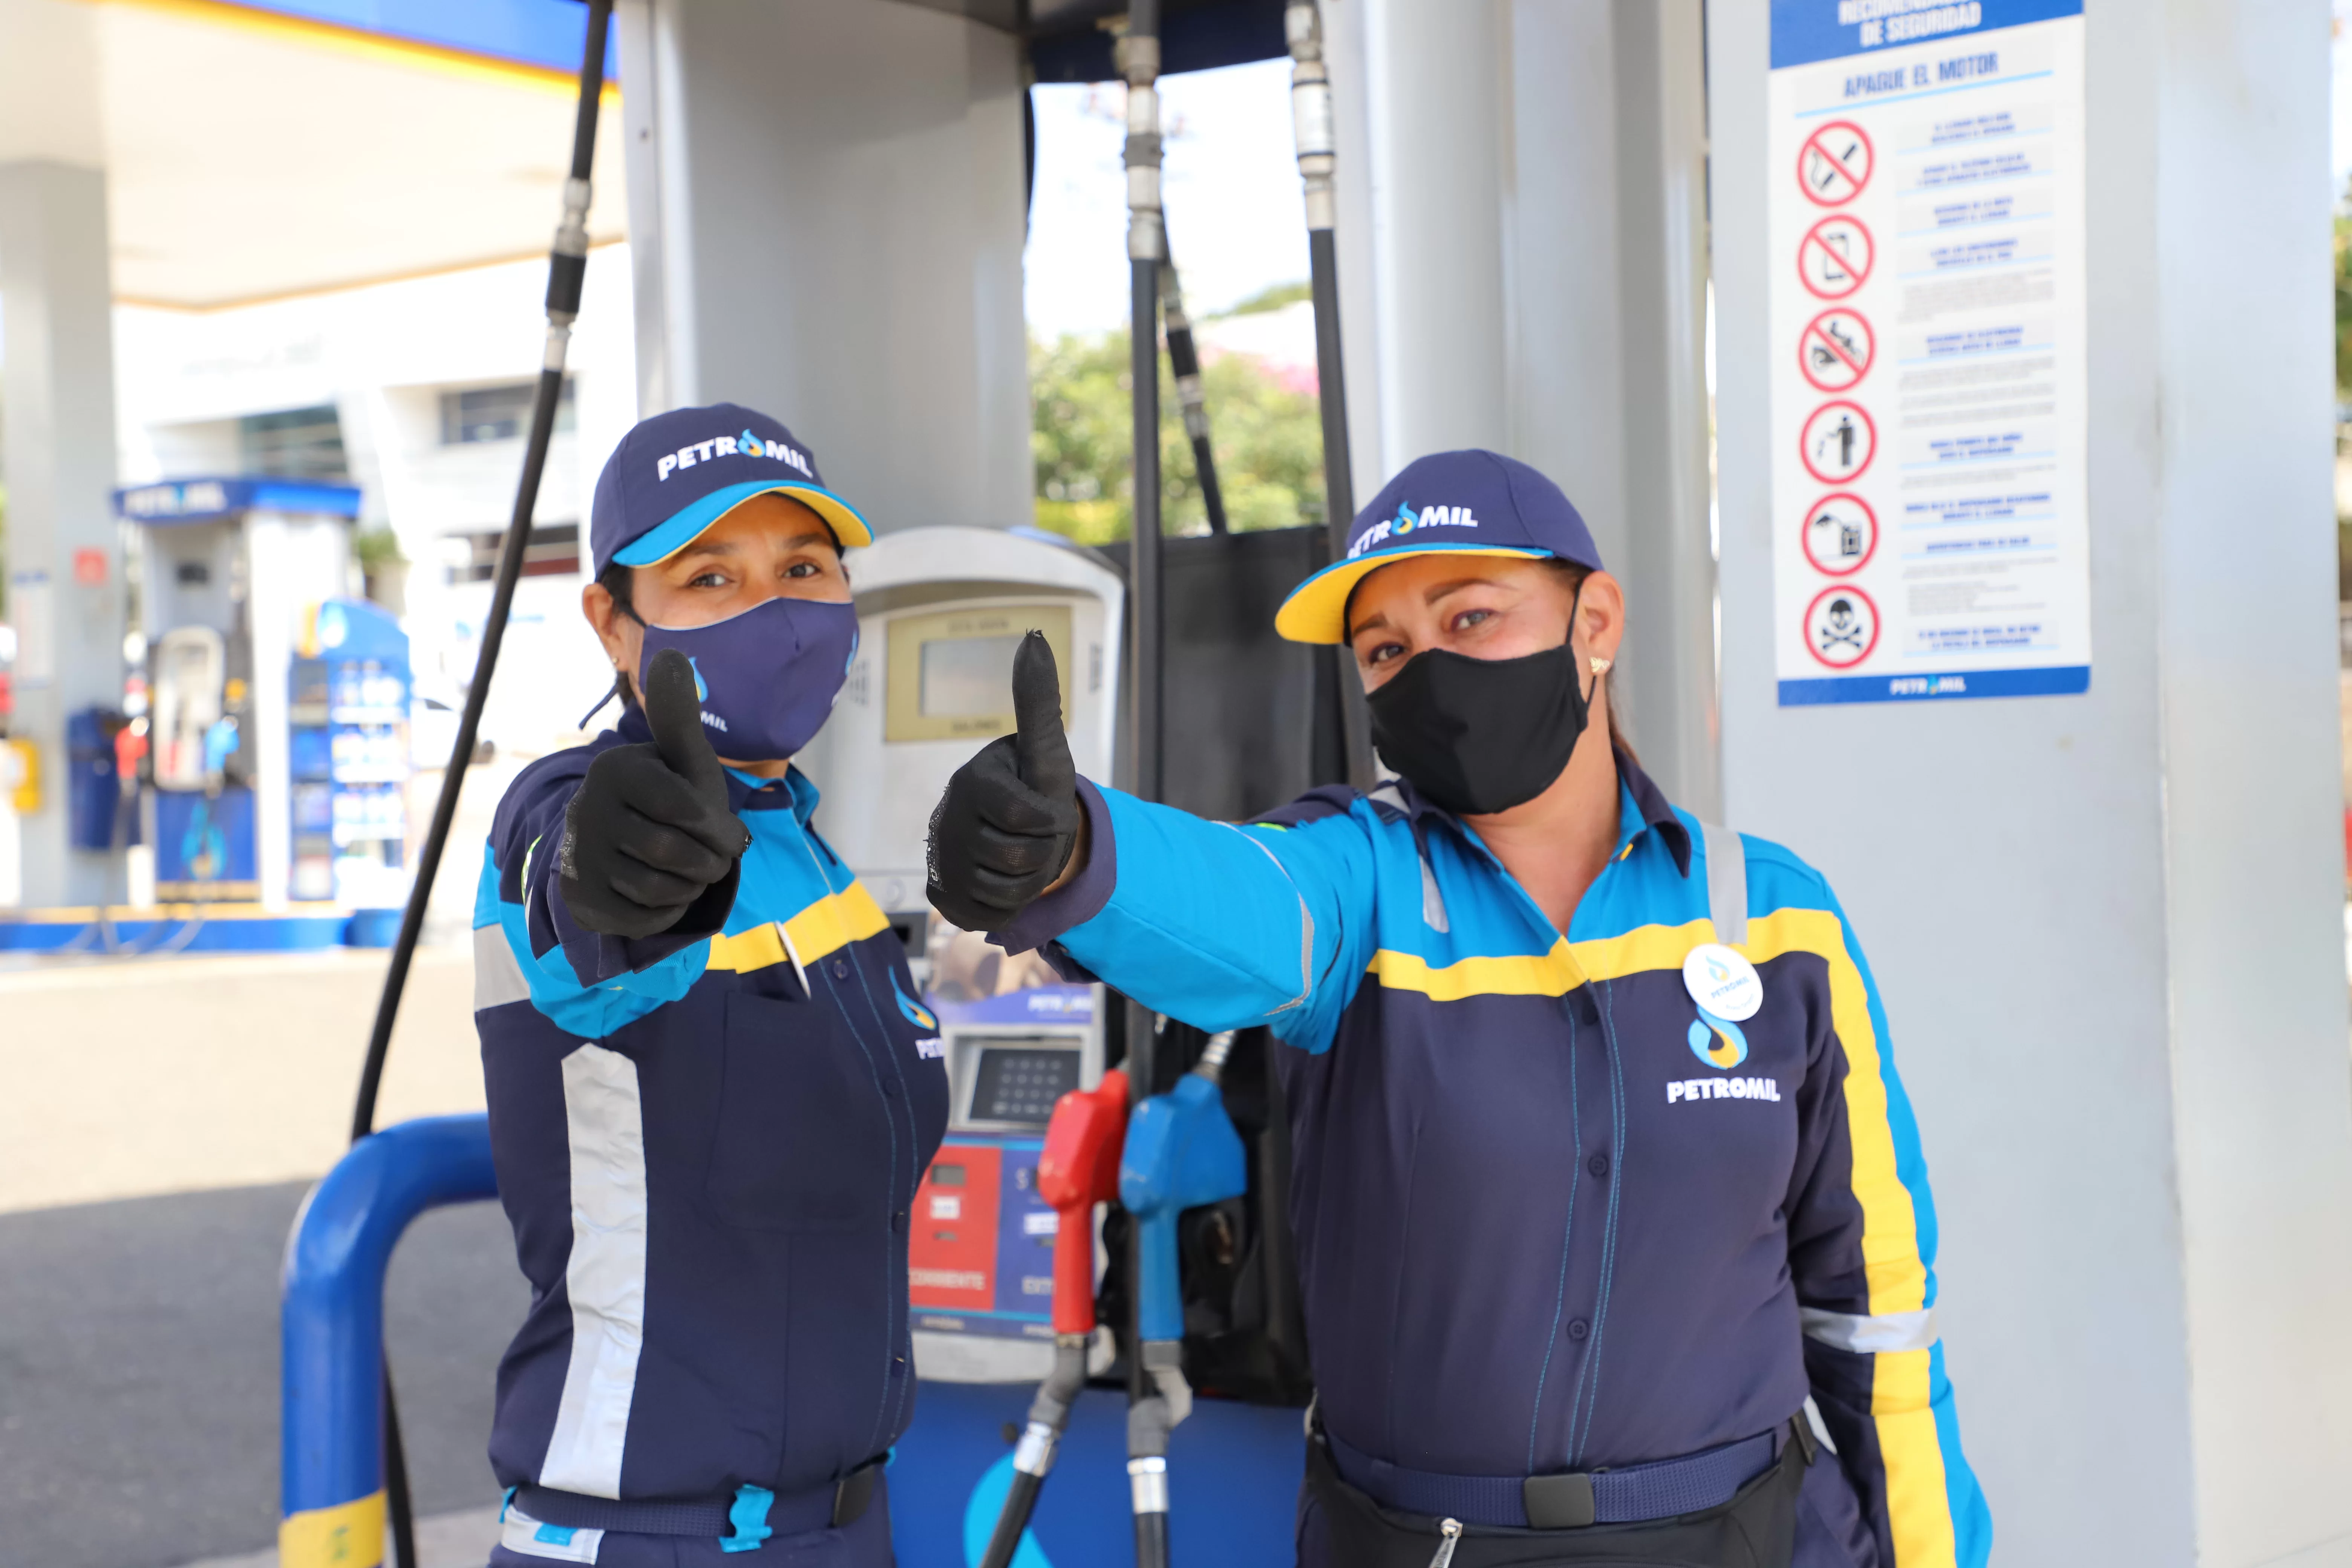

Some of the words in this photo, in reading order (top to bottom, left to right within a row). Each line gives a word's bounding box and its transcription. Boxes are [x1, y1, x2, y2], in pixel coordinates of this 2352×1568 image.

[1860, 19, 1884, 47] DE
[1886, 2, 1981, 42] SEGURIDAD
[1844, 68, 1906, 98] APAGUE
[1913, 63, 1930, 86] EL
[1938, 52, 1999, 81] MOTOR
[1710, 975, 1750, 999] PETROMIL
[1666, 1077, 1781, 1104] PETROMIL
